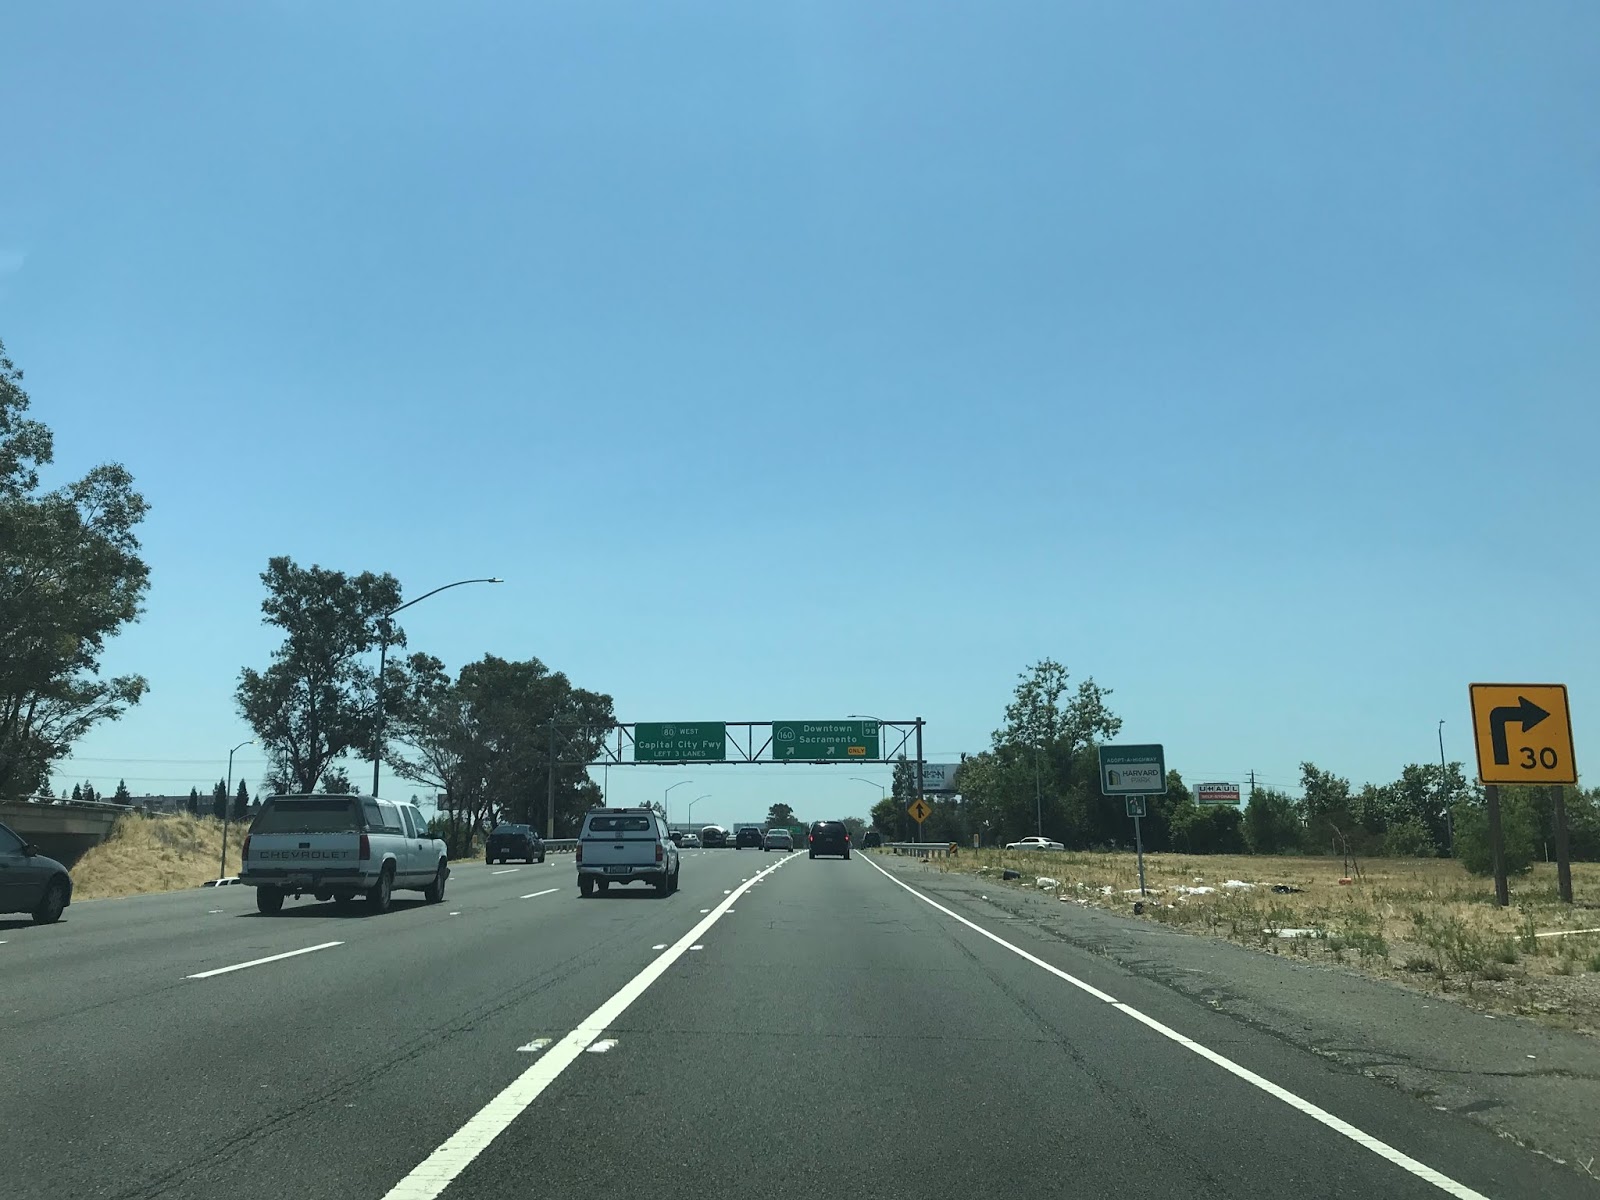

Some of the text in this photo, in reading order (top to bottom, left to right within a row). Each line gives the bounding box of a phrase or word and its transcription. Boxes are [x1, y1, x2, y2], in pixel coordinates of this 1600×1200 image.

[663, 728, 674, 736] 80
[803, 724, 852, 733] Downtown
[780, 731, 793, 739] 160
[799, 735, 857, 744] Sacramento
[638, 740, 722, 750] Capital City Fwy
[1520, 746, 1558, 770] 30
[1122, 769, 1159, 777] HARVARD
[260, 851, 349, 859] CHEVROLET
